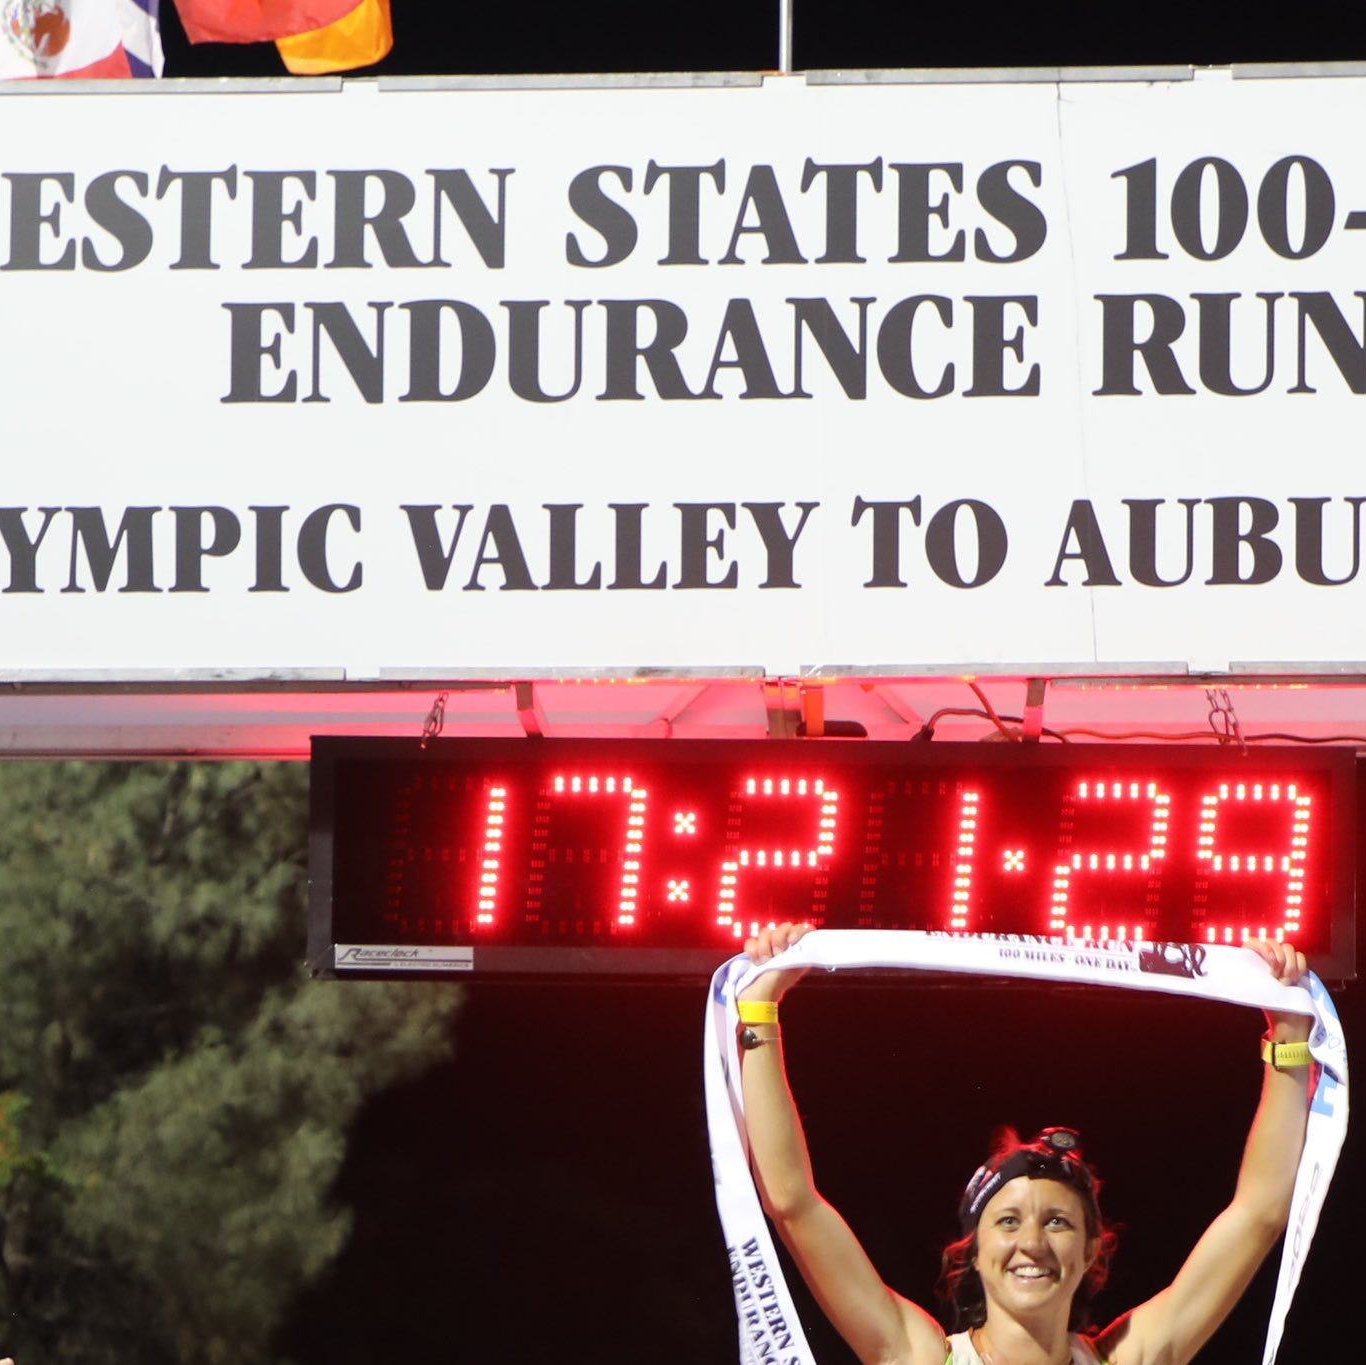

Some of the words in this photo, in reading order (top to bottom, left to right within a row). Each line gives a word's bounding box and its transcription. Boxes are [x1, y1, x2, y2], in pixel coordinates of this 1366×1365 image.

[564, 156, 1048, 268] STATES
[220, 293, 1041, 404] ENDURANCE
[399, 501, 820, 591] VALLEY
[851, 494, 1009, 589] TO
[1024, 950, 1065, 964] MILES
[1075, 955, 1101, 968] ONE
[741, 1237, 795, 1351] WESTERN
